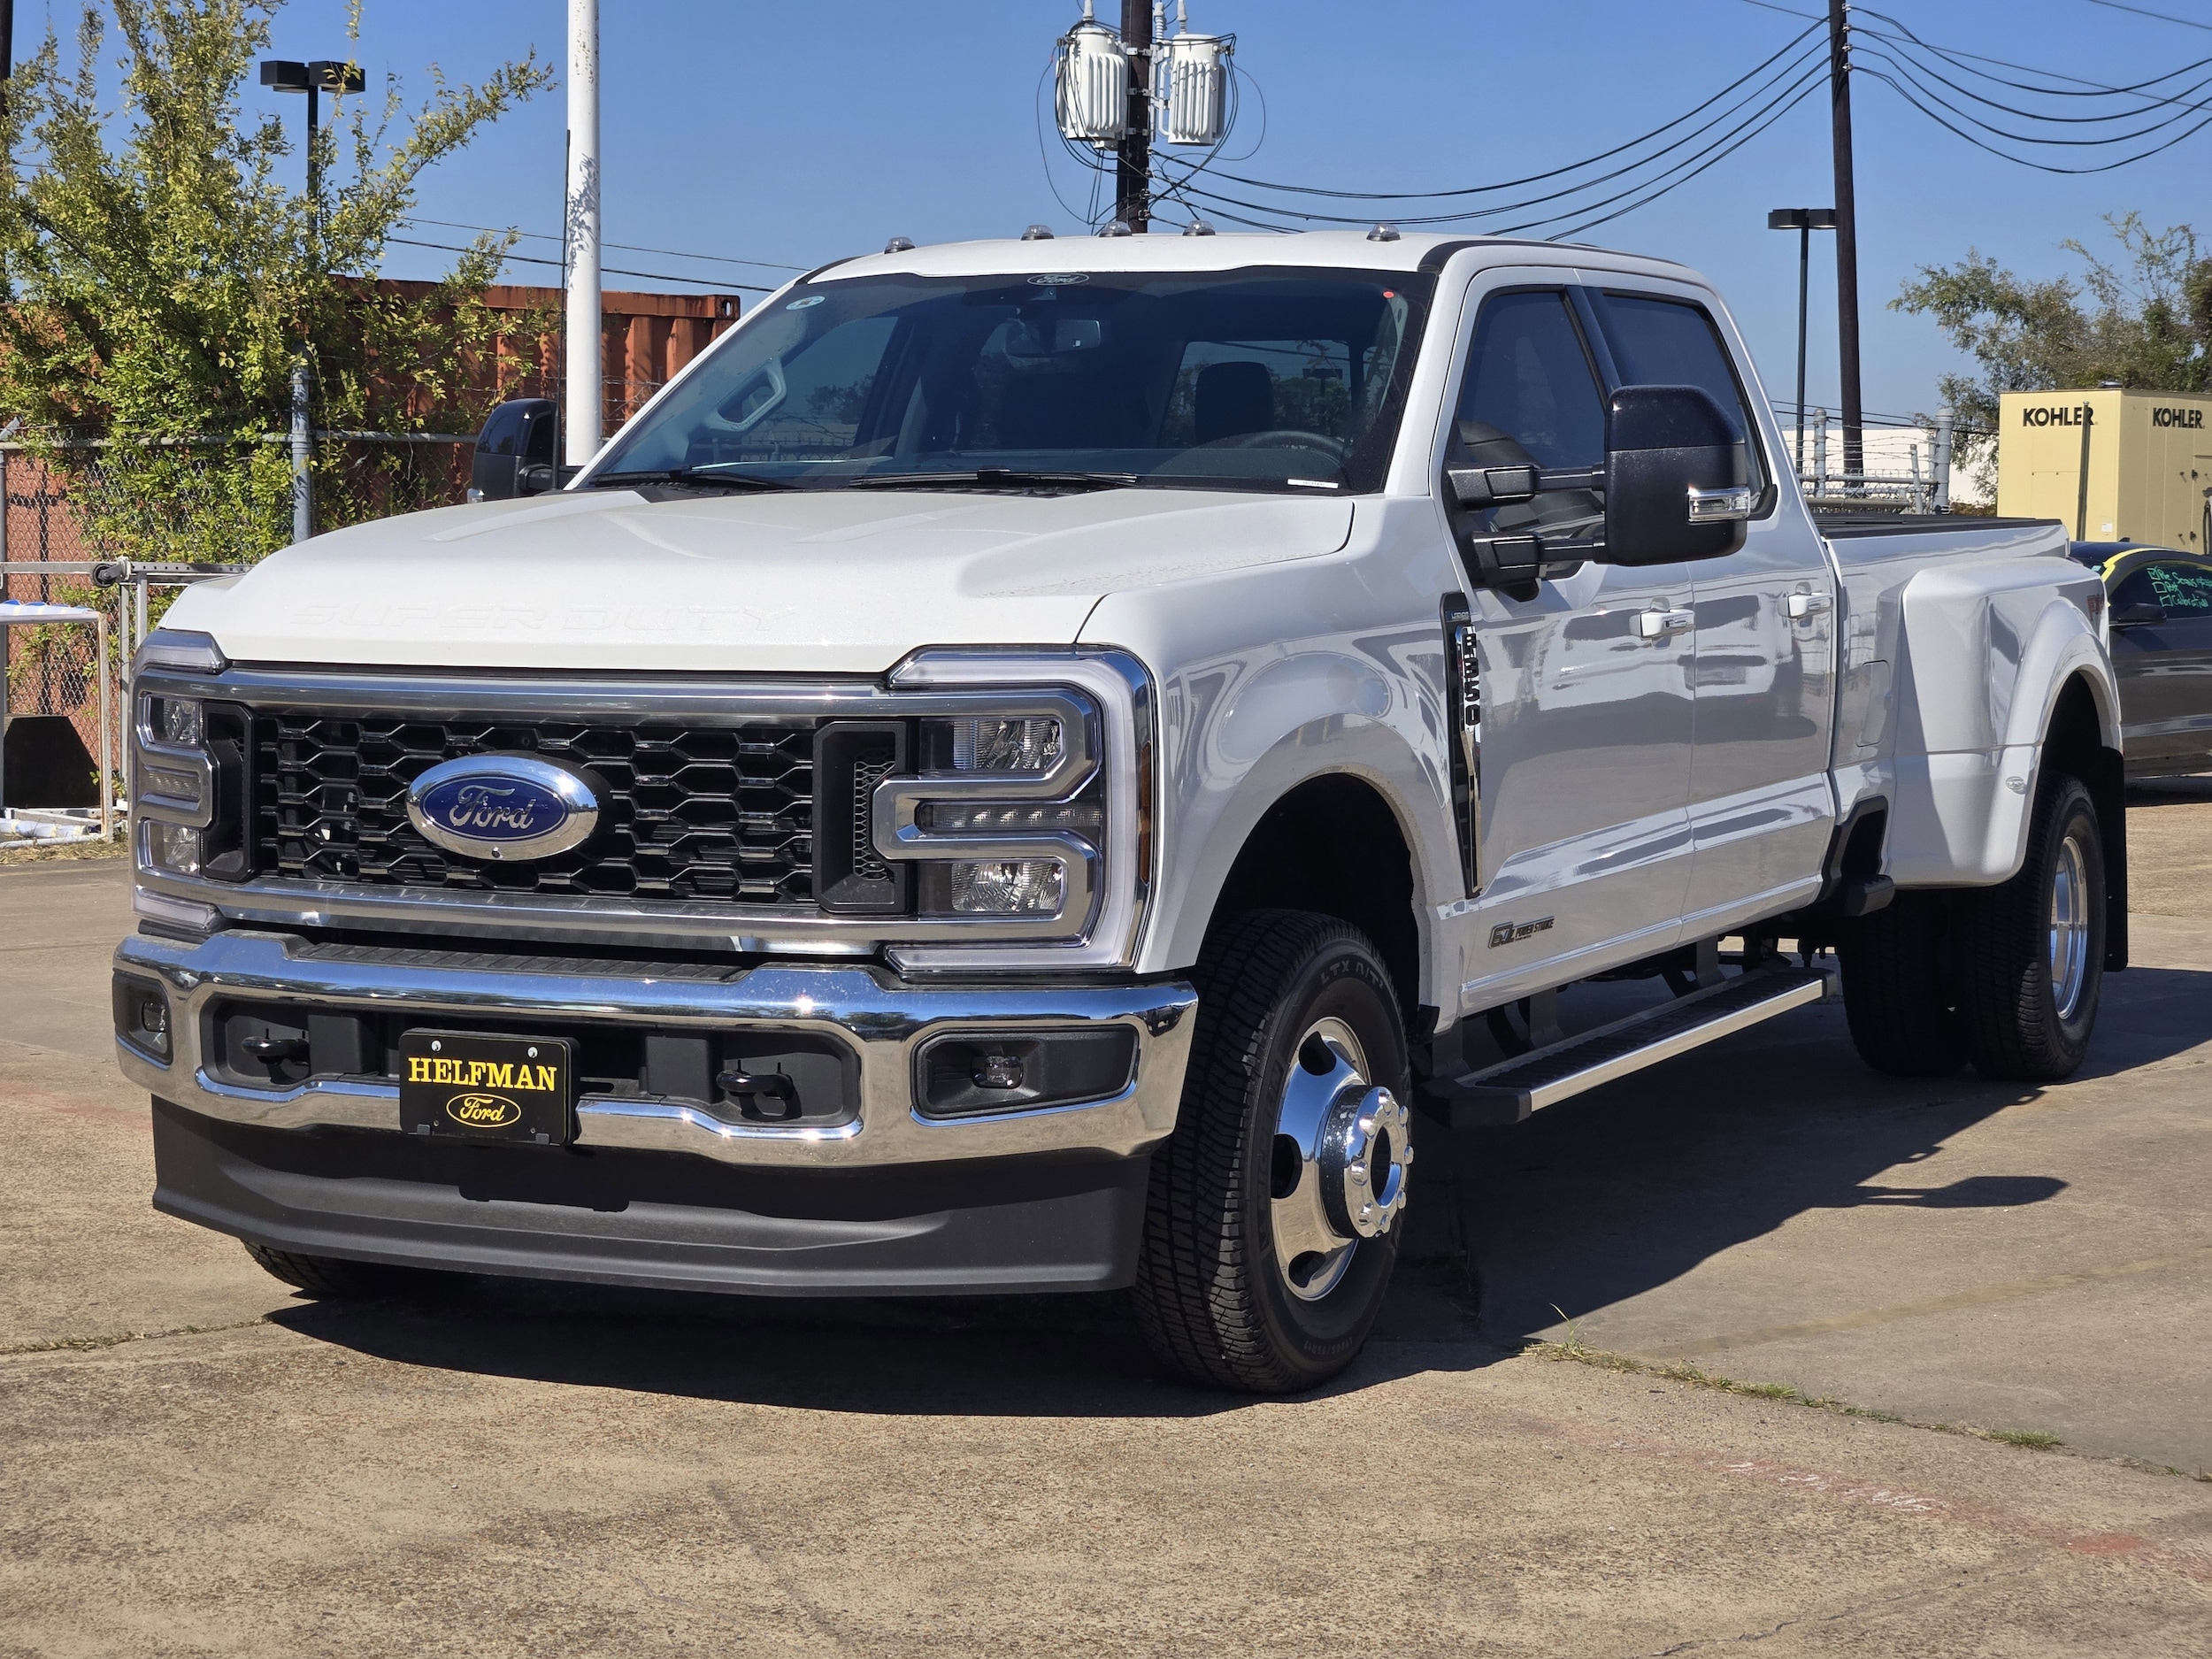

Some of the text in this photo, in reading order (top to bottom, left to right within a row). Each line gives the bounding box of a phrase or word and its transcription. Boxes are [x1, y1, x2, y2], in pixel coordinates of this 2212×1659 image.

[1036, 274, 1079, 284] Ford
[2023, 406, 2094, 426] KOHLER
[2153, 408, 2203, 429] KOHLER
[290, 604, 797, 632] SUPER DUTY
[449, 784, 536, 830] Ford
[1320, 960, 1349, 985] LTX
[408, 1057, 557, 1091] HELFMAN
[459, 1096, 506, 1122] Ford
